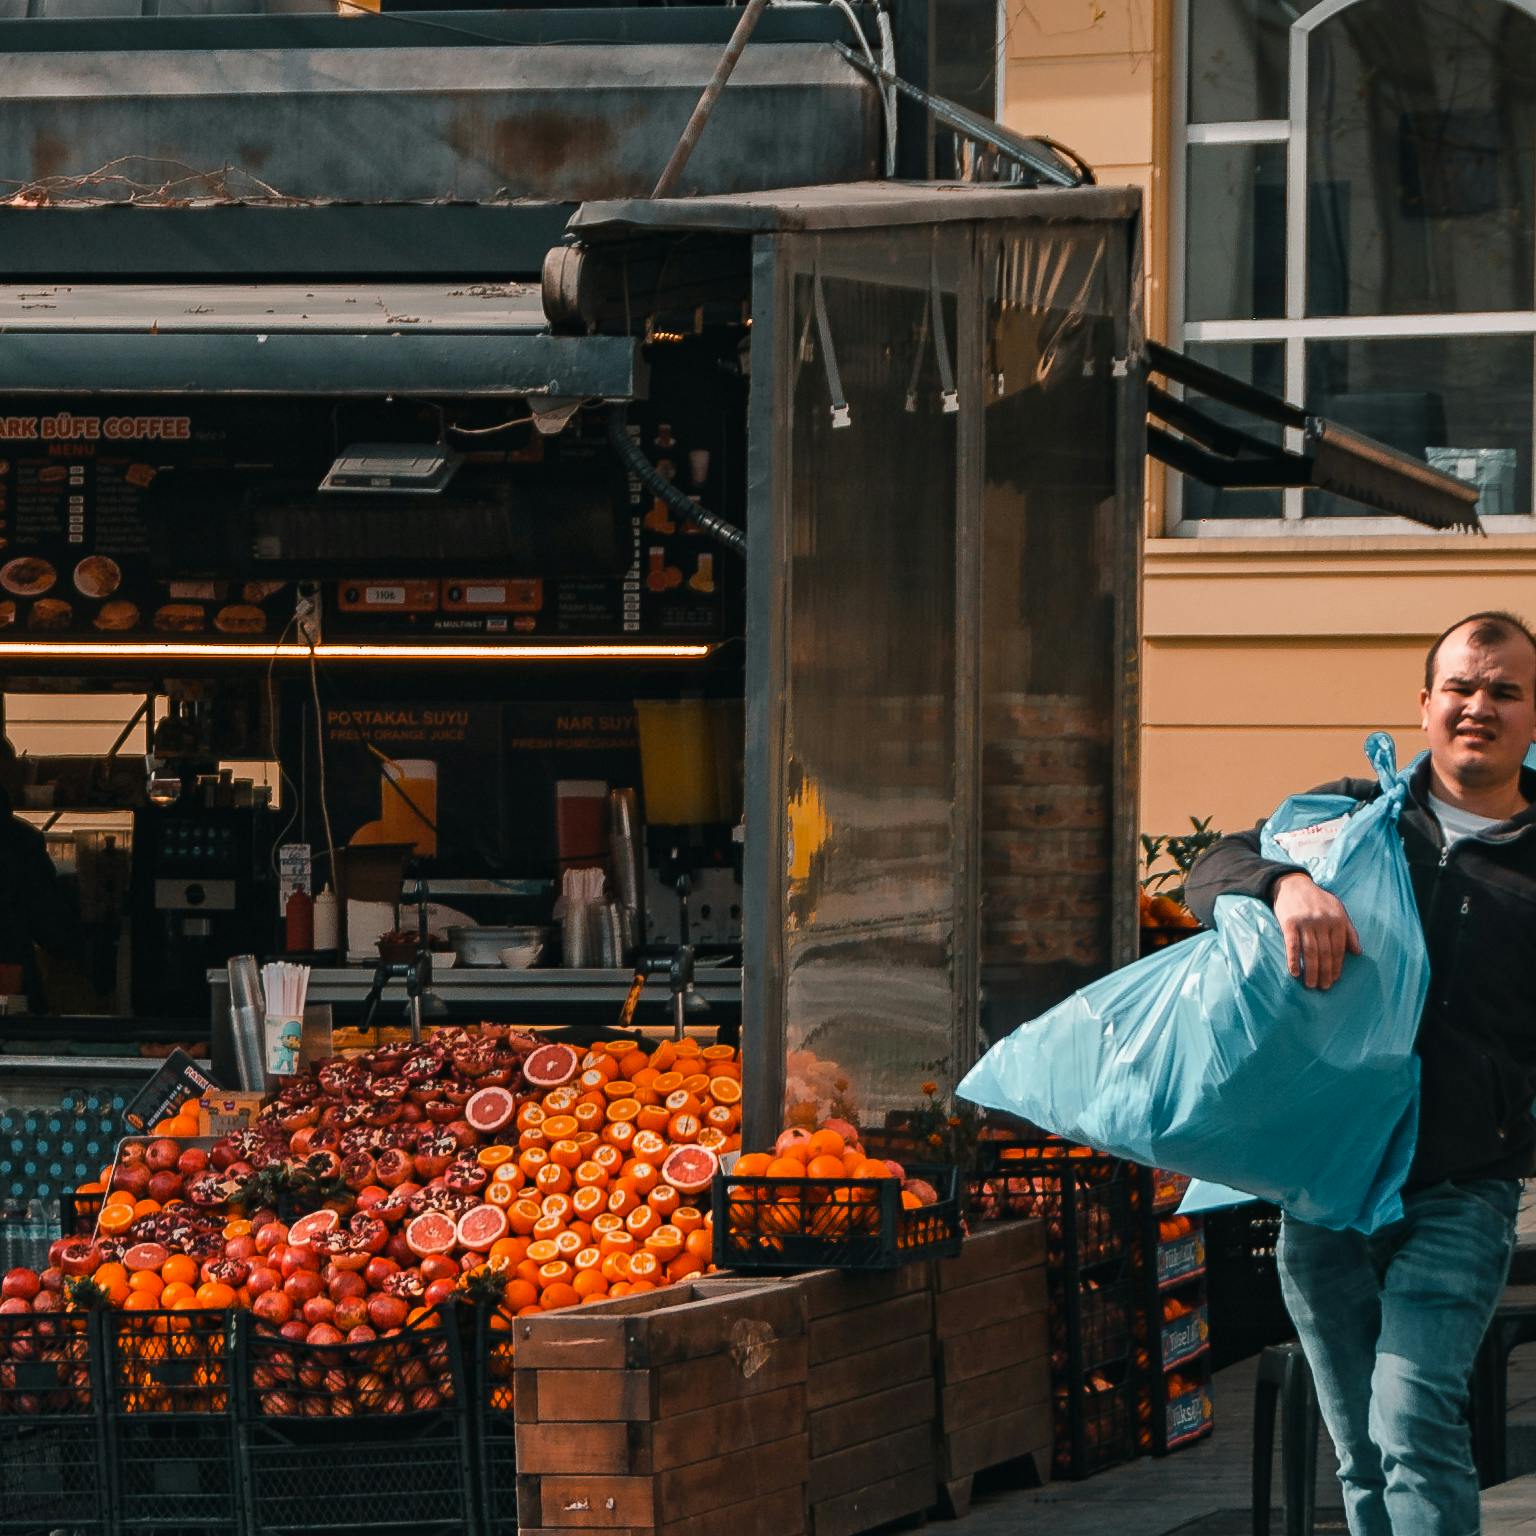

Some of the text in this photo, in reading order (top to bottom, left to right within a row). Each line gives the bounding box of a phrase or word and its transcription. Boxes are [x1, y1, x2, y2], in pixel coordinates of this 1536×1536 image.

[40, 410, 101, 440] BÜFE
[104, 416, 192, 440] COFFEE
[327, 710, 469, 726] PORTAKAL SUYU
[556, 715, 593, 732] NAR
